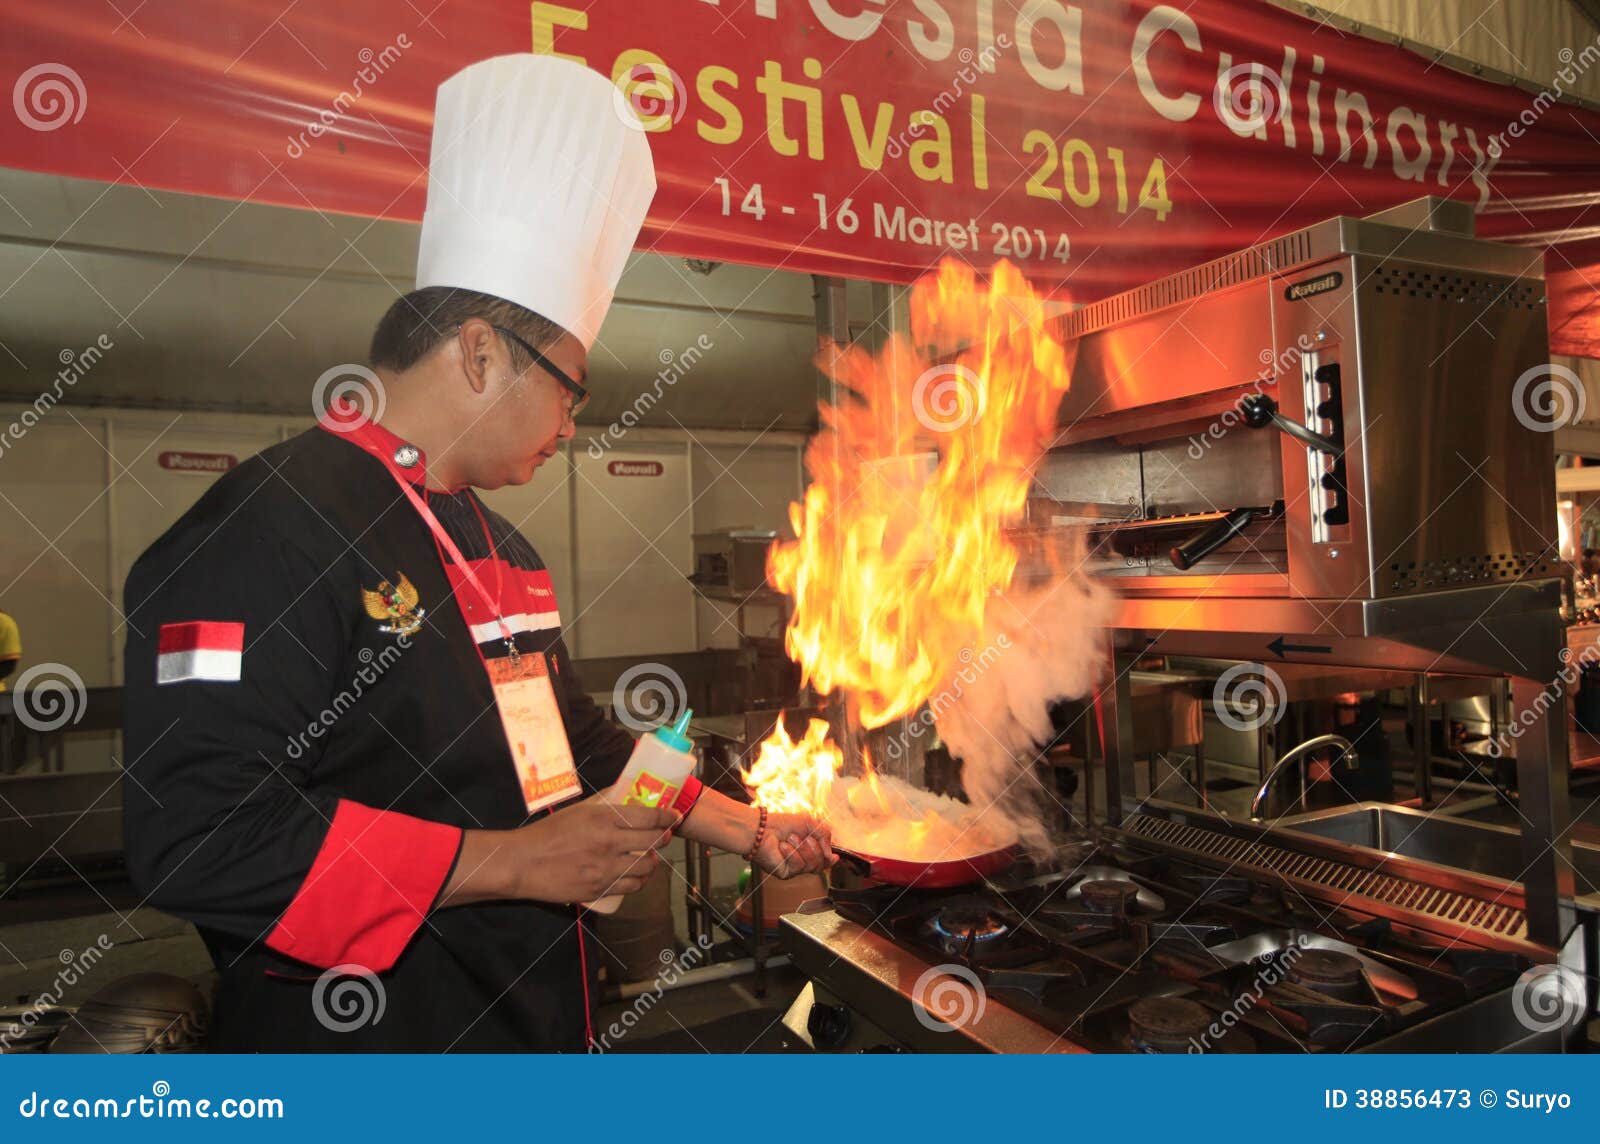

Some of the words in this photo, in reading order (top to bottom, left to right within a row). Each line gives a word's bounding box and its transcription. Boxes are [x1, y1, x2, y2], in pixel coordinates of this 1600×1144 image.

[531, 1, 989, 190] Festival
[1022, 130, 1173, 222] 2014
[1131, 5, 1502, 213] Culinary
[714, 177, 767, 221] 14
[812, 193, 860, 234] 16
[873, 203, 979, 252] Maret
[992, 223, 1071, 264] 2014
